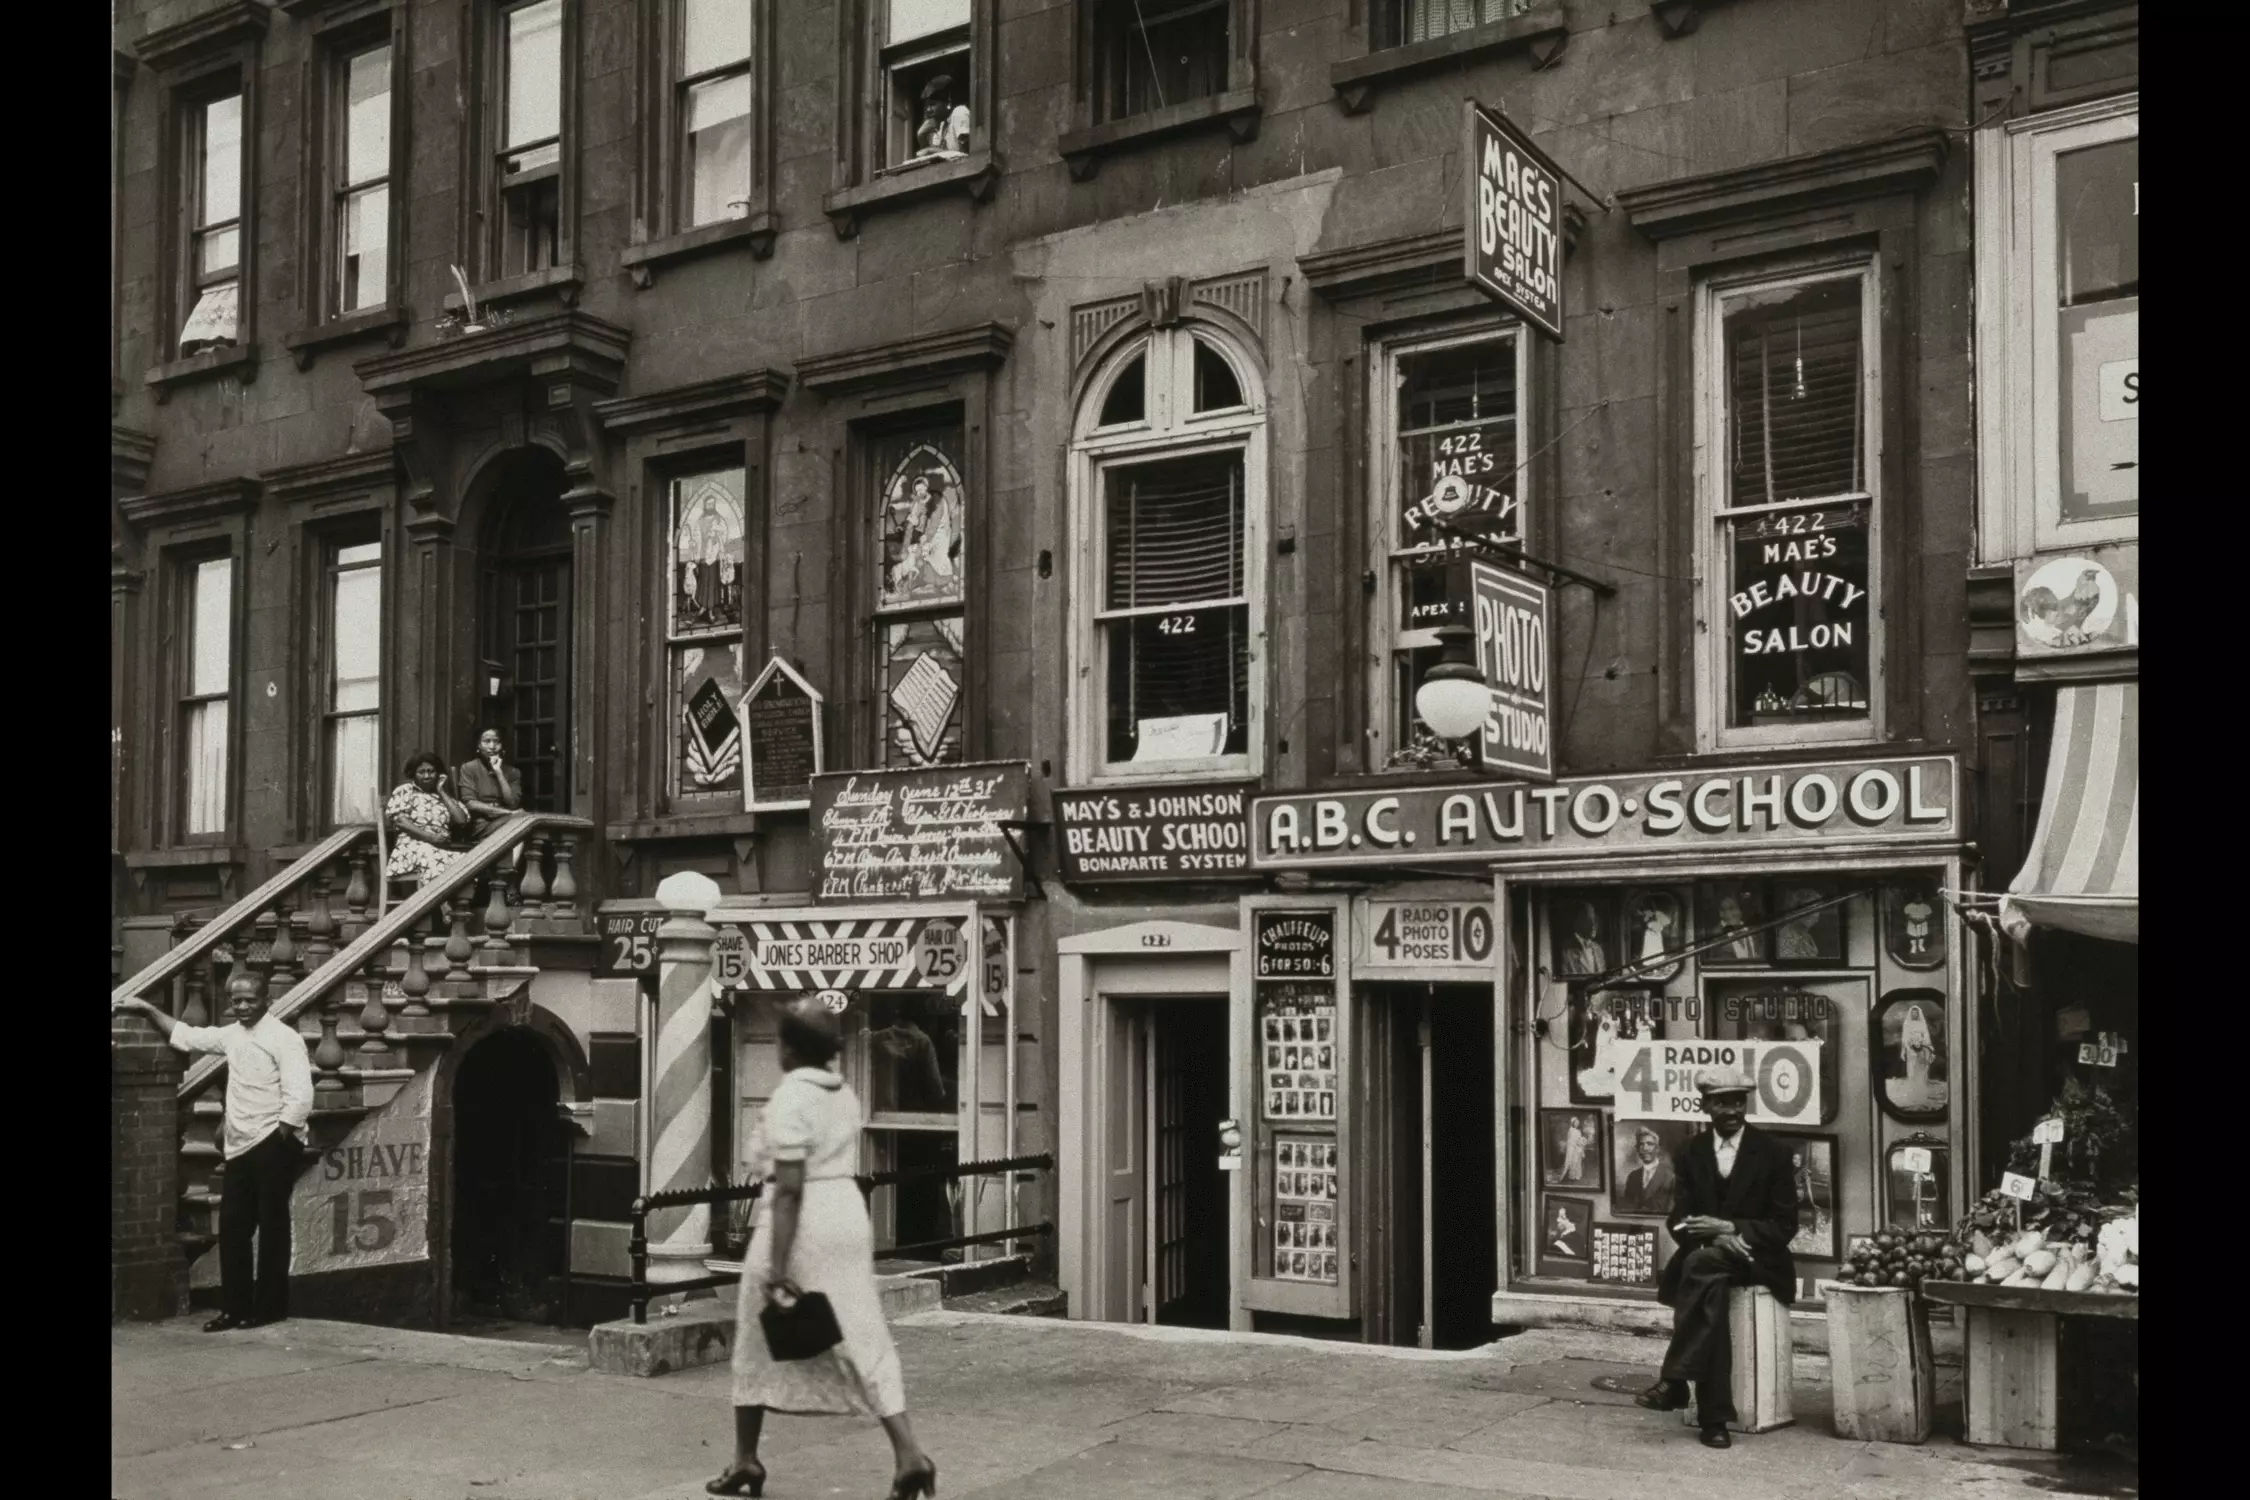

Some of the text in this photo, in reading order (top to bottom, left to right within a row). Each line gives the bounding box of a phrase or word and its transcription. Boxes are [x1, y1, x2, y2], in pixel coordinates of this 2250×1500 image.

[1483, 133, 1551, 224] MAE'S
[1479, 175, 1557, 276] BEAUTY
[1515, 281, 1546, 312] SYSTEM
[1440, 433, 1481, 455] 422
[1433, 453, 1494, 479] MAE'S
[1404, 484, 1519, 530] BEUTY
[1775, 513, 1825, 535] 422
[1764, 534, 1836, 564] MAE'S
[1729, 571, 1865, 619] BEAUTY
[1411, 603, 1449, 617] APEX
[1159, 615, 1196, 635] 422
[1743, 622, 1852, 654] SALON
[1478, 594, 1544, 692] PHOTO
[1485, 702, 1547, 756] STUDIO
[833, 775, 893, 807] Sunday
[1062, 788, 1245, 822] MAY'S & JOHNSON'
[1269, 797, 1416, 850] A.B.C.
[1066, 825, 1151, 854] BEAUTY
[1079, 853, 1247, 872] BONAPARTE SYSTEM
[607, 917, 664, 934] HAIR CUT
[1402, 908, 1449, 922] RADIO
[717, 936, 744, 951] SHAVE
[924, 928, 957, 945] HAIR CUT
[1262, 920, 1329, 948] CHAUFFEUR
[1374, 907, 1400, 960] 4
[1402, 925, 1449, 940] PHOTO
[761, 942, 904, 966] JONES BARBER SHOP
[1274, 942, 1314, 951] PHOTOS
[1403, 944, 1449, 959] POSES
[1260, 955, 1269, 974] 6
[1271, 958, 1291, 971] FOR
[821, 994, 845, 1010] 24
[1610, 994, 1829, 1021] PHOTO STUDIO
[1664, 1047, 1735, 1065] RADIO
[1620, 1047, 1659, 1112] 4
[1671, 1097, 1702, 1113] POS
[324, 1142, 423, 1182] SHAVE
